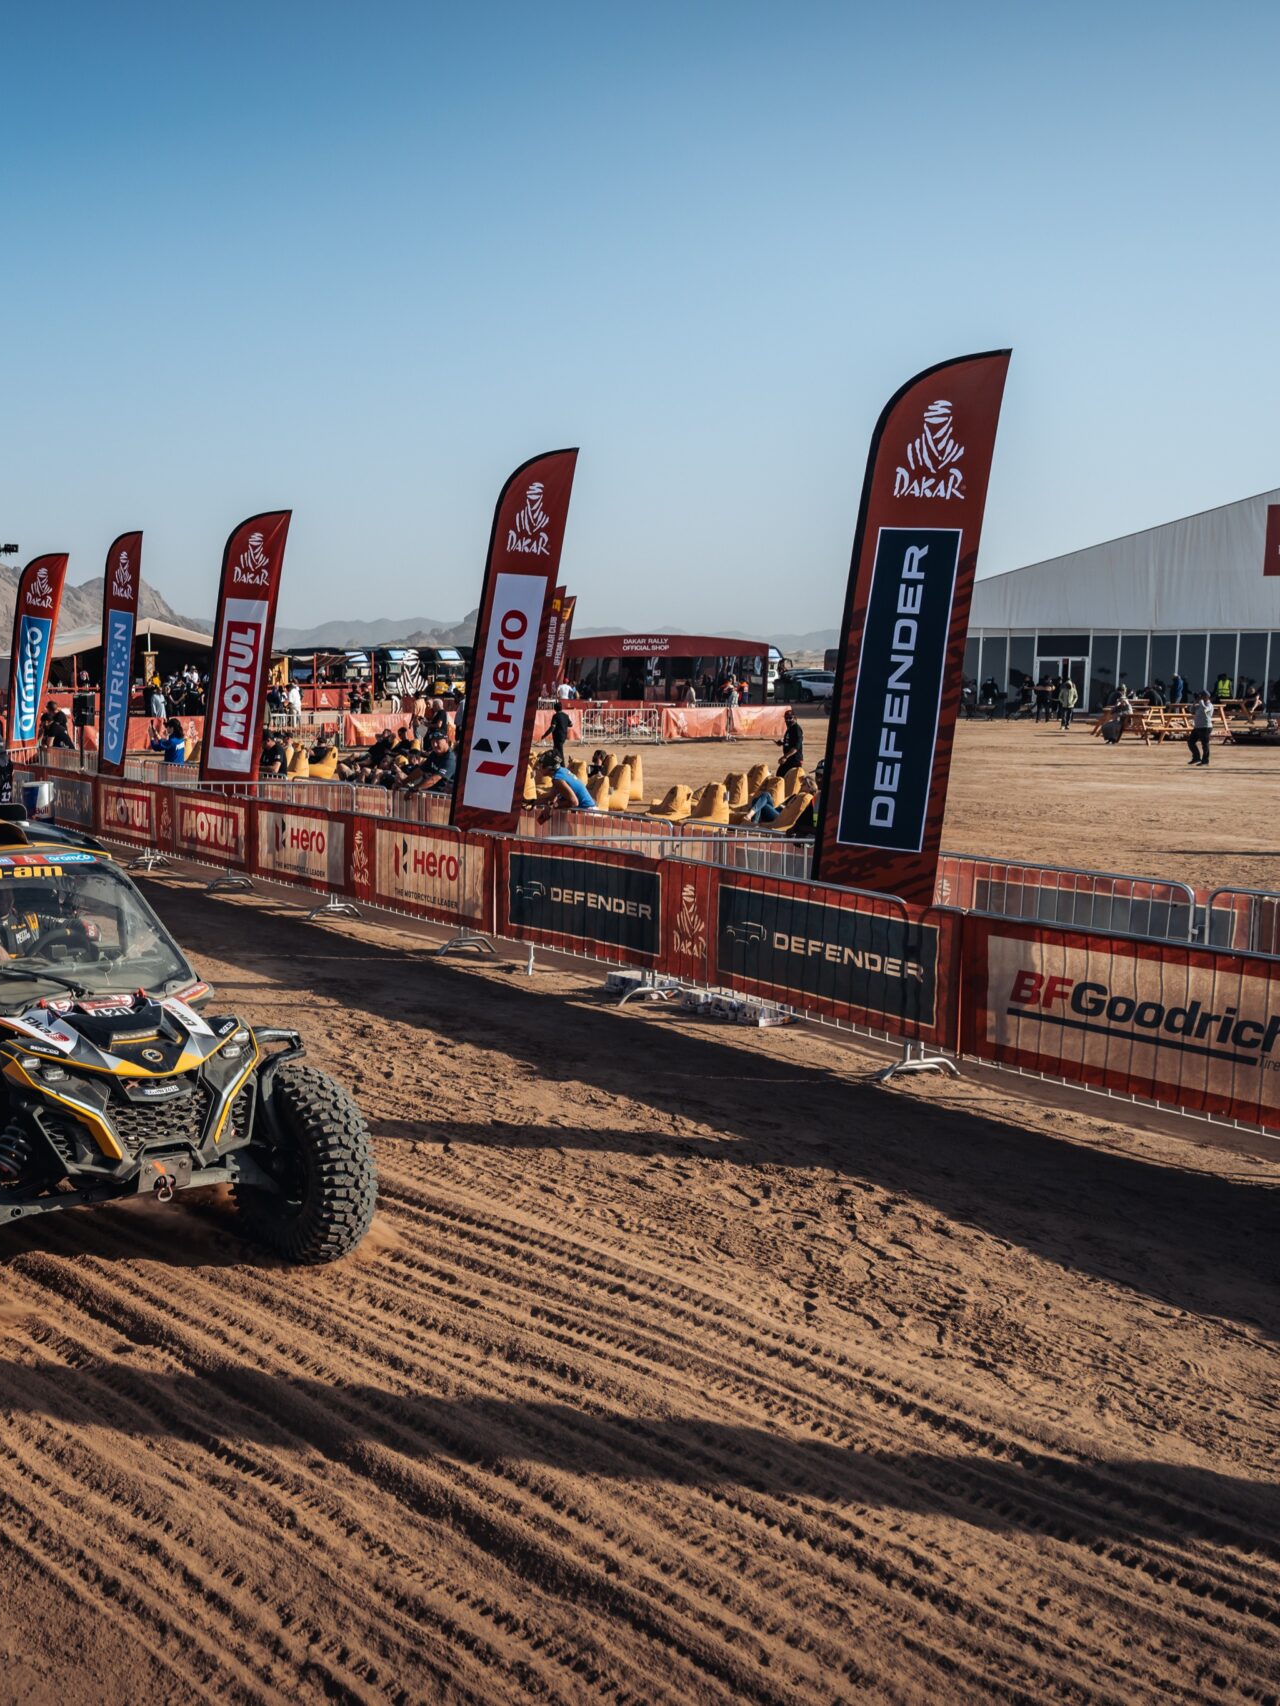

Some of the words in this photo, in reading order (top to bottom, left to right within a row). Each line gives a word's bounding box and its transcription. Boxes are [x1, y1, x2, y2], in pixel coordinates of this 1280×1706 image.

[893, 466, 966, 500] DAKAR
[506, 530, 551, 556] DAKAR
[112, 582, 134, 600] DAKAR
[233, 568, 270, 586] DAKAR
[26, 592, 53, 609] DAKAR
[548, 616, 558, 634] CLUB
[546, 634, 555, 658] DAKAR
[554, 638, 564, 666] OFFICIAL
[20, 626, 43, 732] aramco
[486, 610, 528, 724] Hero
[107, 622, 127, 750] CATRION
[220, 628, 255, 745] MOTUL
[870, 544, 929, 828] DEFENDER
[105, 797, 149, 828] MOTUL
[182, 809, 236, 848] MOTUL
[290, 827, 326, 854] Hero
[48, 853, 91, 862] aramco
[284, 862, 308, 874] MOTORCYCLE
[309, 866, 326, 878] LEADER
[413, 849, 460, 882] Hero
[352, 868, 370, 886] DAKAR
[395, 888, 404, 896] THE
[404, 890, 436, 905] MOTORCYCLE
[438, 896, 458, 908] LEADER
[550, 886, 652, 920] DEFENDER
[672, 931, 708, 960] DAKAR
[772, 932, 924, 983] DEFENDER
[1010, 969, 1280, 1052] BFGoodrich
[22, 1016, 52, 1034] Elka
